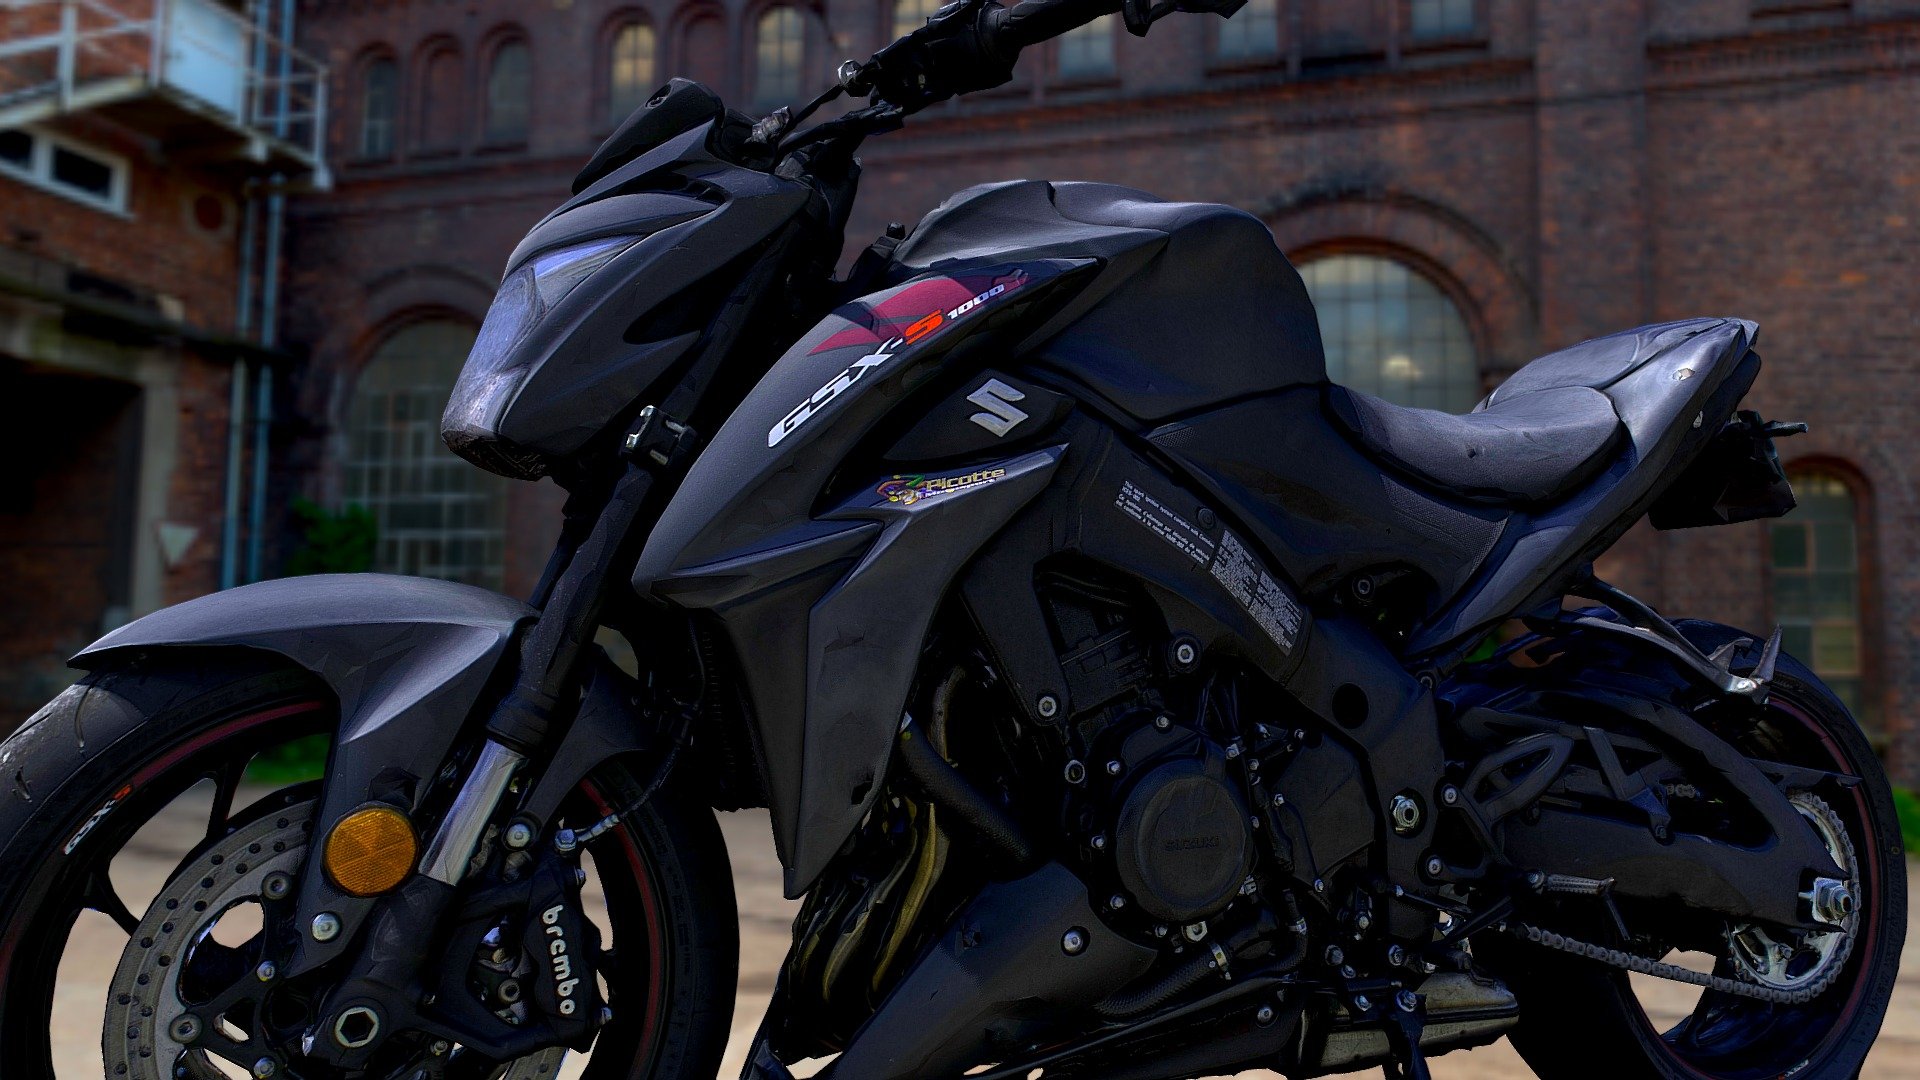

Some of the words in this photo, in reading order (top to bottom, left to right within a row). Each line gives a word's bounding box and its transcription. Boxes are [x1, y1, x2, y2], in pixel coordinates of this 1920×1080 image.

[768, 309, 943, 448] GSX-S
[947, 284, 1005, 320] 1000
[926, 467, 1006, 491] Picotte
[542, 904, 580, 1015] brembo
